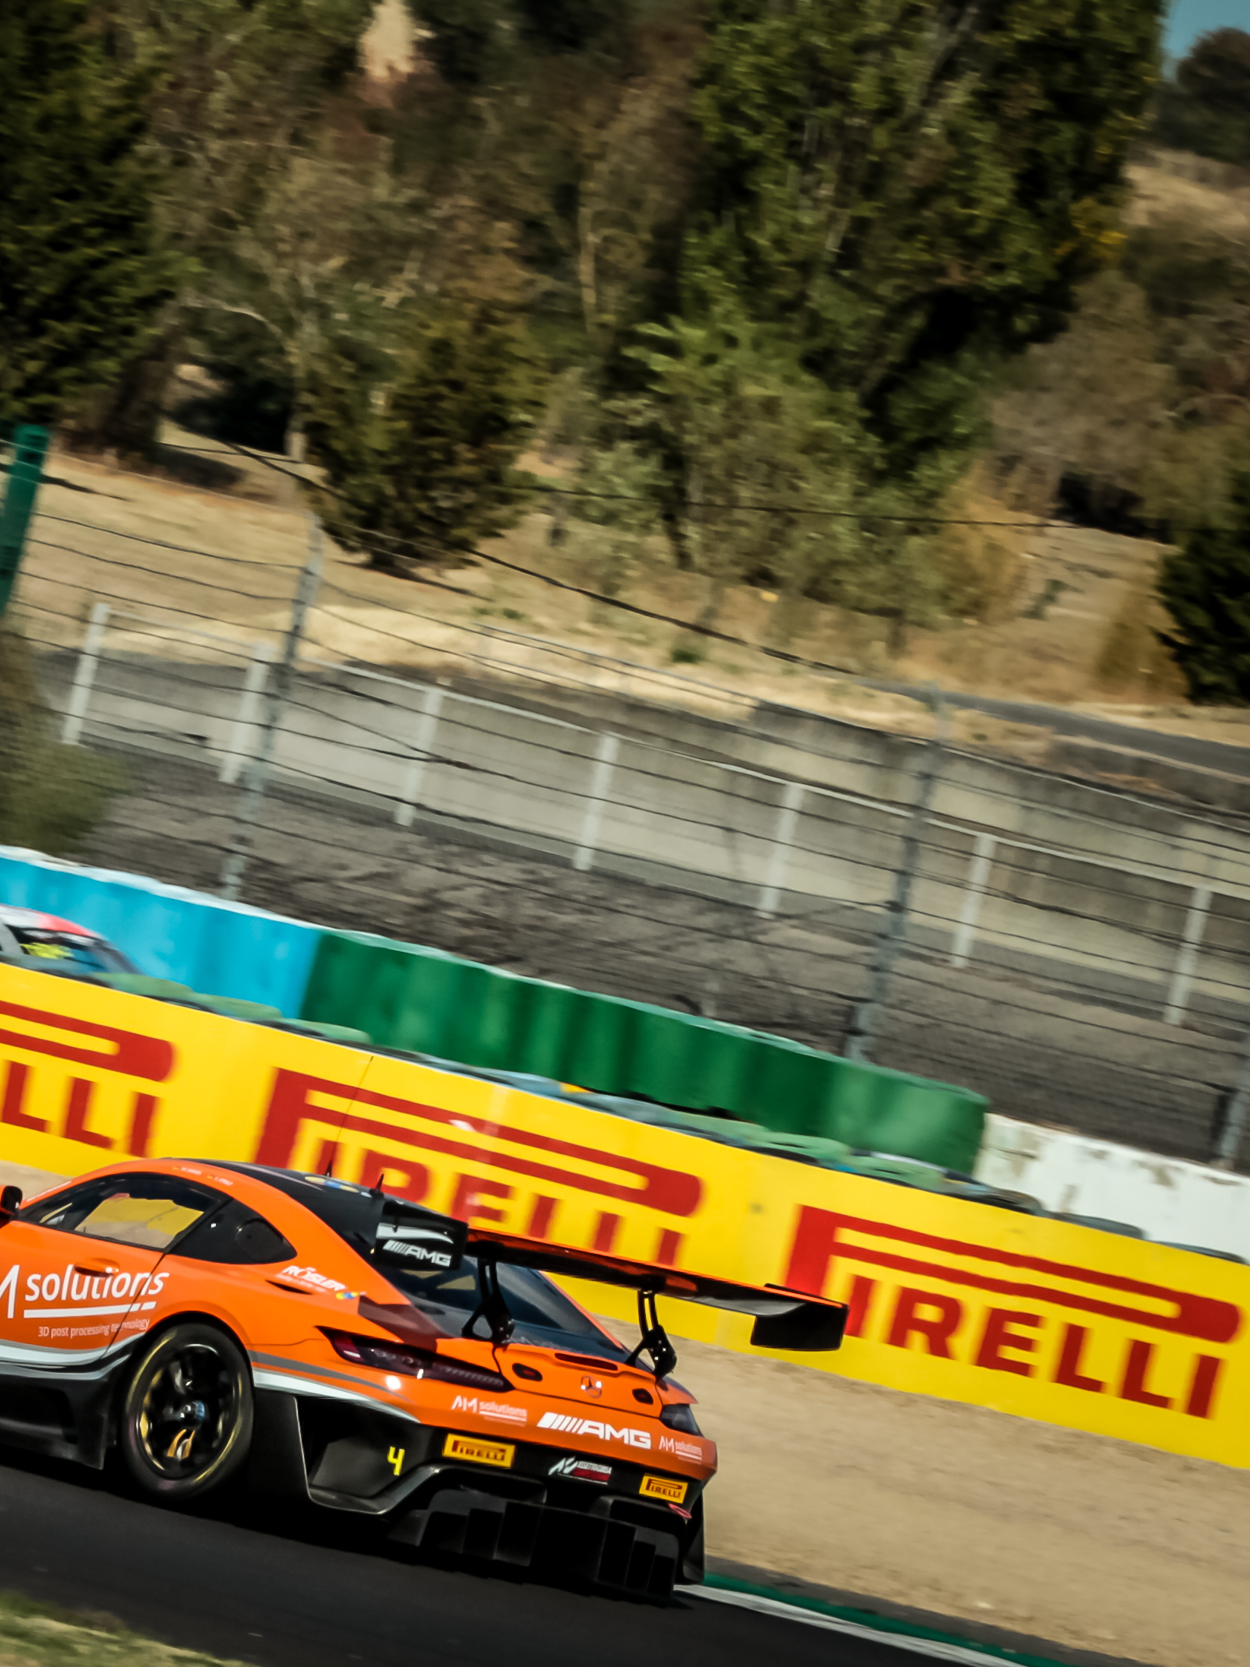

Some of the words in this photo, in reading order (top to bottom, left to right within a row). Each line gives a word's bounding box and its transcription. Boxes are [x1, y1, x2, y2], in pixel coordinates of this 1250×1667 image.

[405, 1245, 452, 1268] AMG
[25, 1264, 170, 1302] solutions
[783, 1204, 1240, 1420] PIRELLI
[38, 1326, 50, 1338] 3D
[51, 1327, 69, 1339] post
[70, 1324, 110, 1339] processing
[479, 1401, 527, 1417] solutions
[578, 1419, 652, 1450] AMG
[387, 1446, 405, 1476] 4
[451, 1439, 507, 1462] PIRELLI
[646, 1477, 683, 1499] PIRELLI
